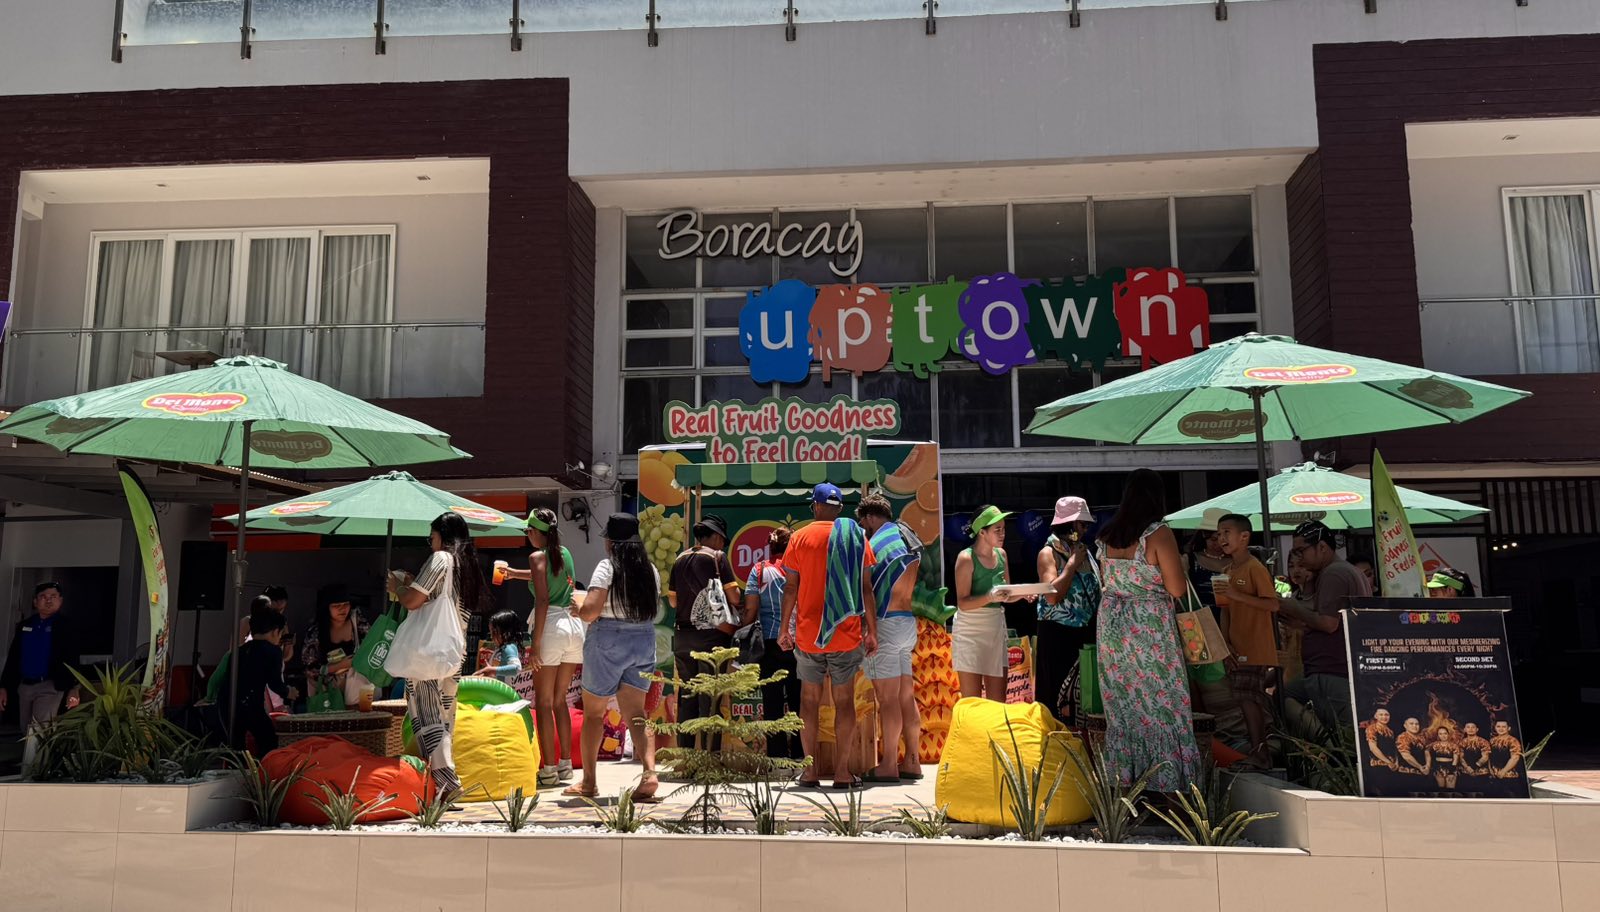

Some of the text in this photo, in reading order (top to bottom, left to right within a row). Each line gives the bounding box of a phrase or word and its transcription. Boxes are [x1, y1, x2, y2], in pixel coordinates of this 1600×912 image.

[657, 209, 864, 277] Boracay
[759, 292, 1177, 359] uptown
[1286, 367, 1349, 377] Monte
[152, 397, 241, 406] Del Monte
[671, 402, 895, 436] Real Fruit Goodness
[712, 436, 860, 463] to Feel Good!
[737, 544, 771, 567] Del
[732, 703, 753, 716] REAL
